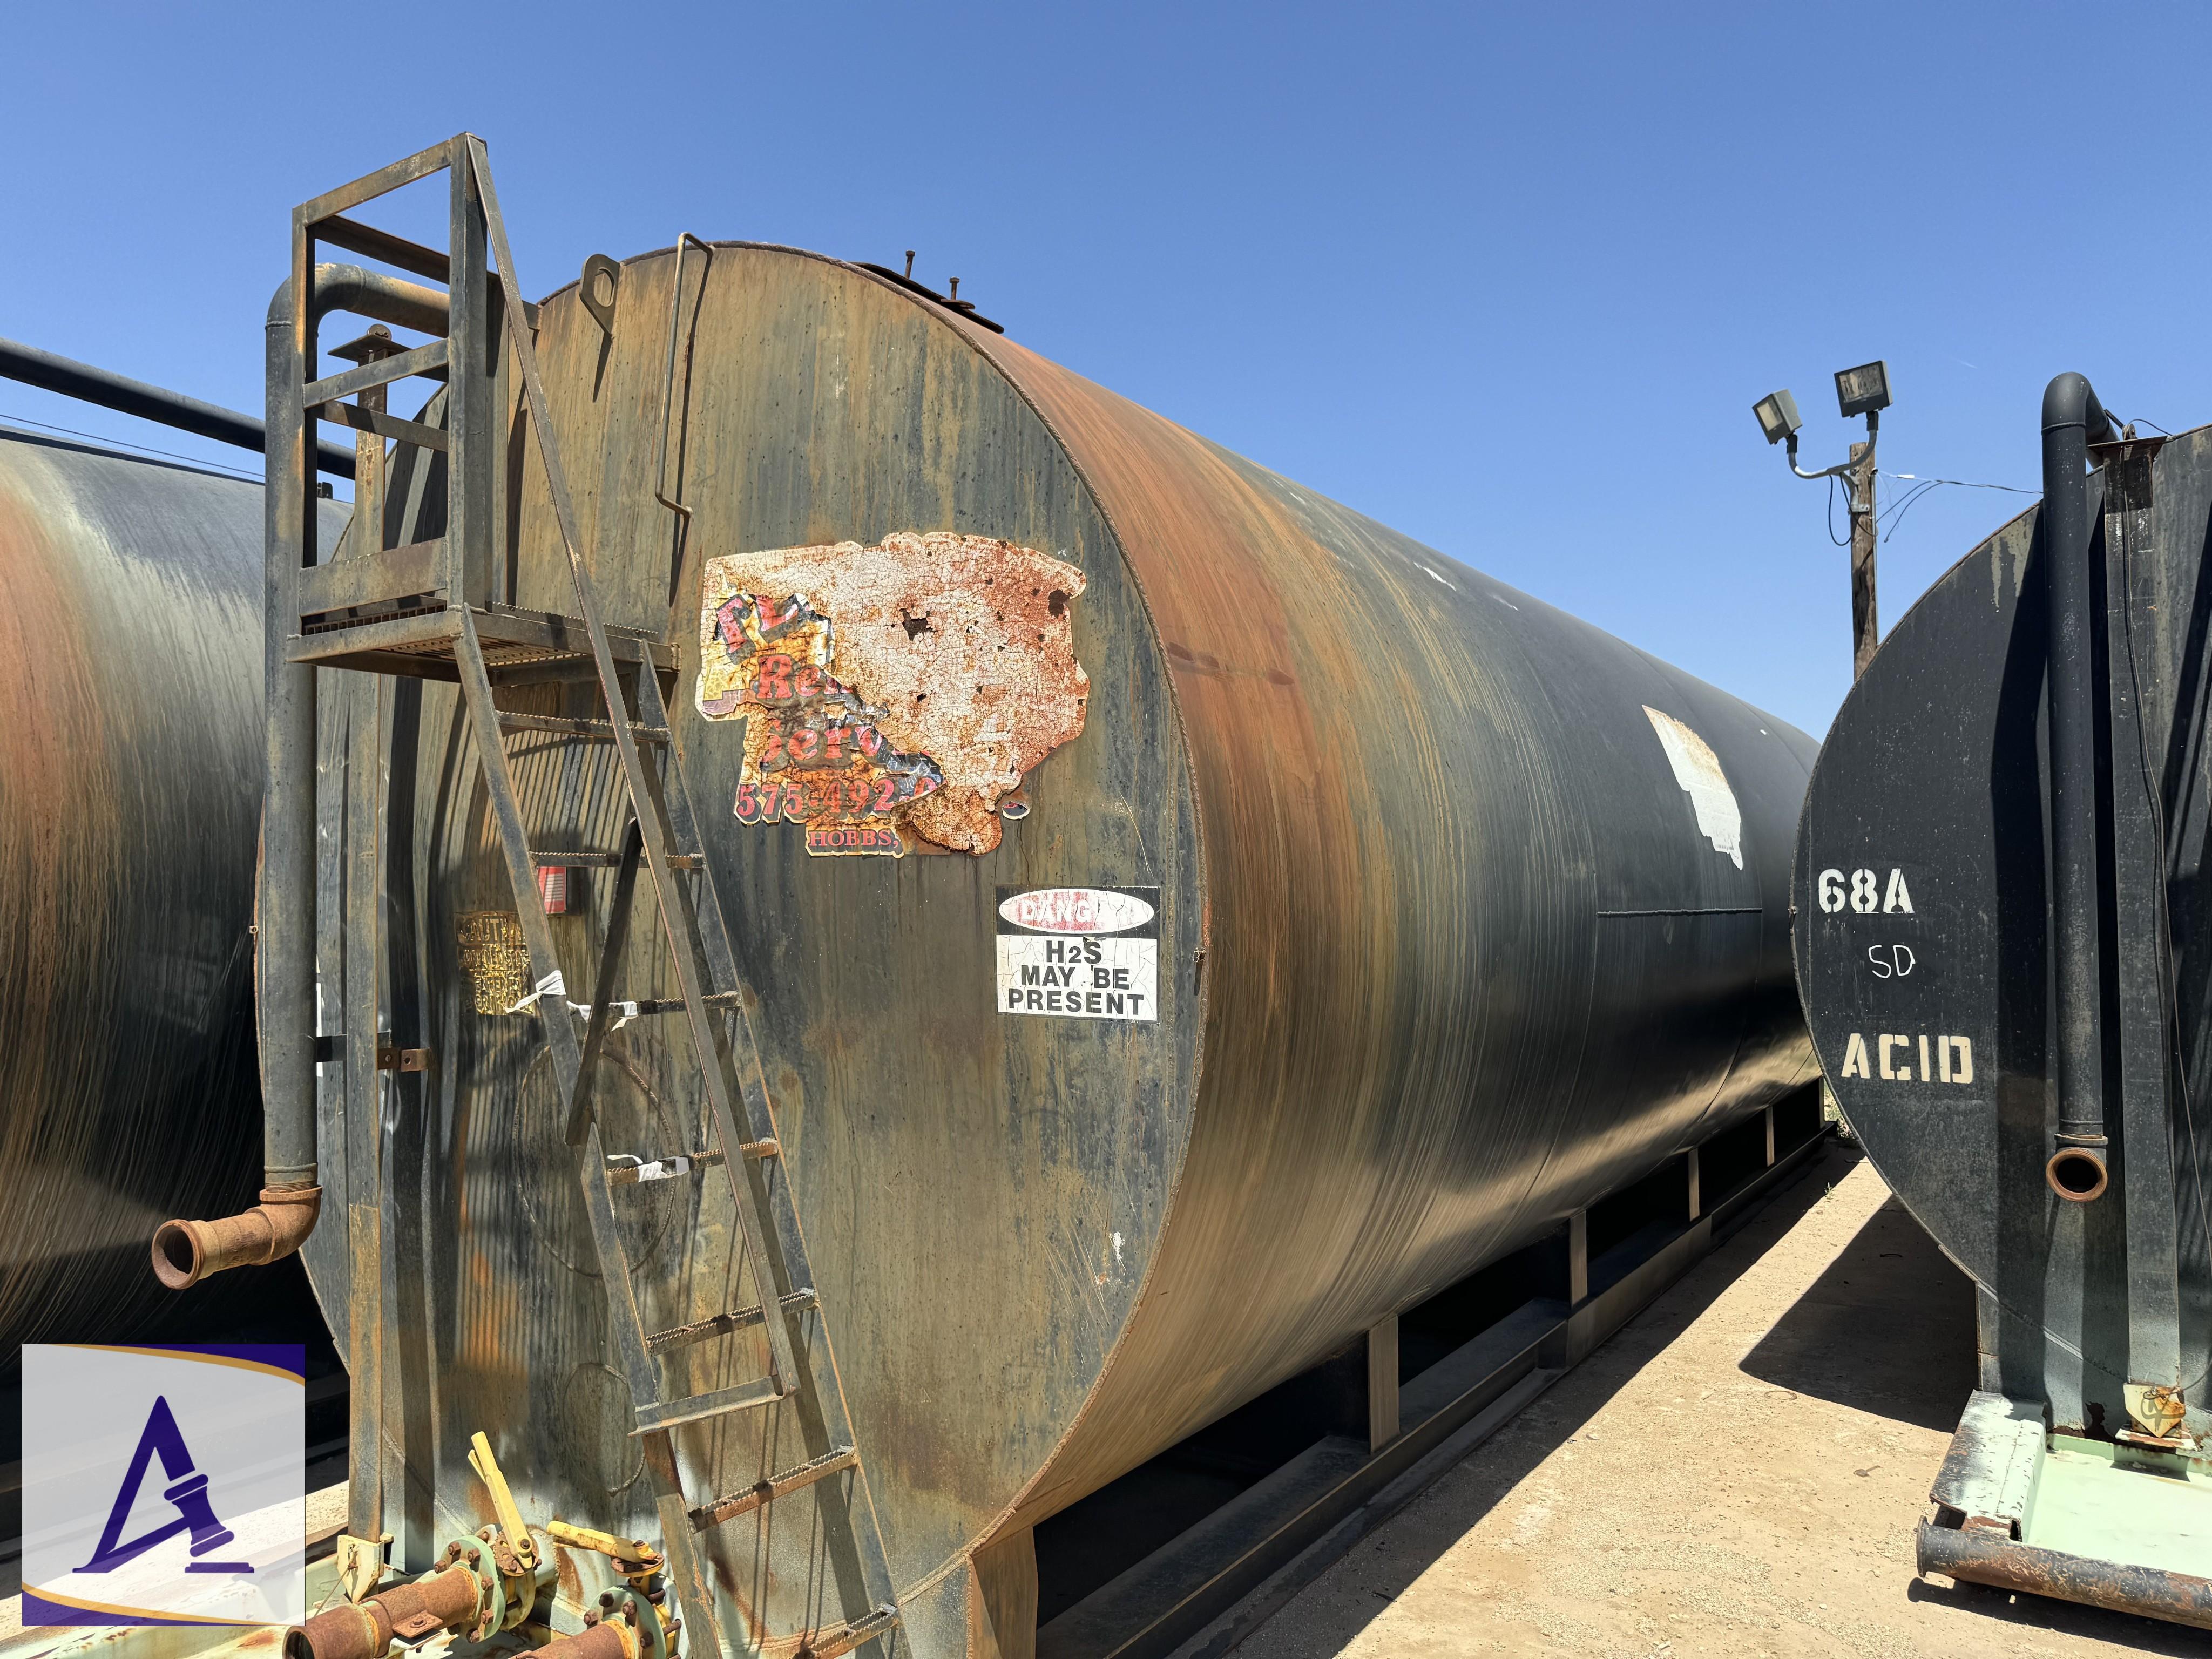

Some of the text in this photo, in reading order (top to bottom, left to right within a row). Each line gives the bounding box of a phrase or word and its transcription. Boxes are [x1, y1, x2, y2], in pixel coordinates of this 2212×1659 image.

[761, 719, 906, 762] Serv
[810, 829, 900, 848] HOBBS,
[1818, 868, 1915, 914] 68A
[1019, 898, 1129, 923] DANG
[1046, 940, 1102, 965] H2S
[1868, 944, 1916, 978] SD
[1020, 965, 1129, 990] MAY BE
[1009, 988, 1144, 1015] PRESENT
[1841, 1033, 1973, 1084] ACID
